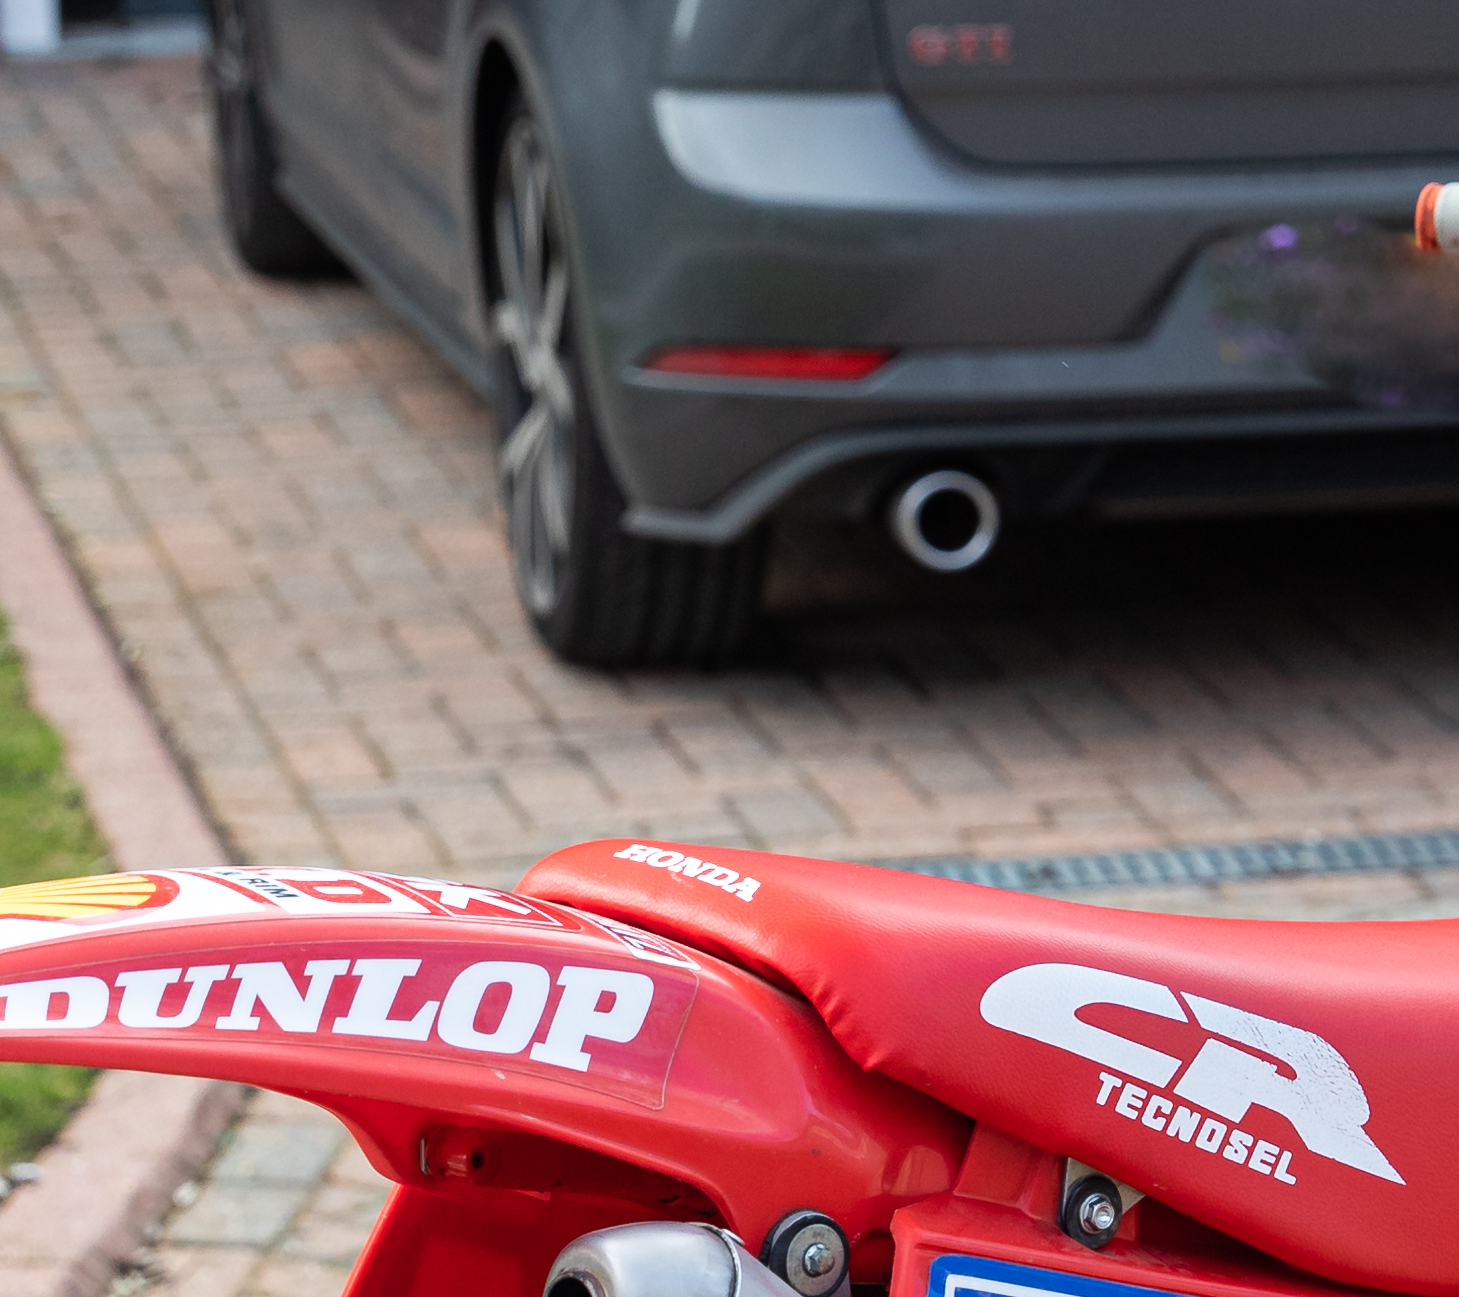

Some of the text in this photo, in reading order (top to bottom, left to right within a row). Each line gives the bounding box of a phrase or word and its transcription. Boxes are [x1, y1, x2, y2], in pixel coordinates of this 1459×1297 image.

[614, 843, 763, 903] HONDA
[979, 962, 1407, 1186] CR
[1094, 1071, 1298, 1187] TECNOSEL
